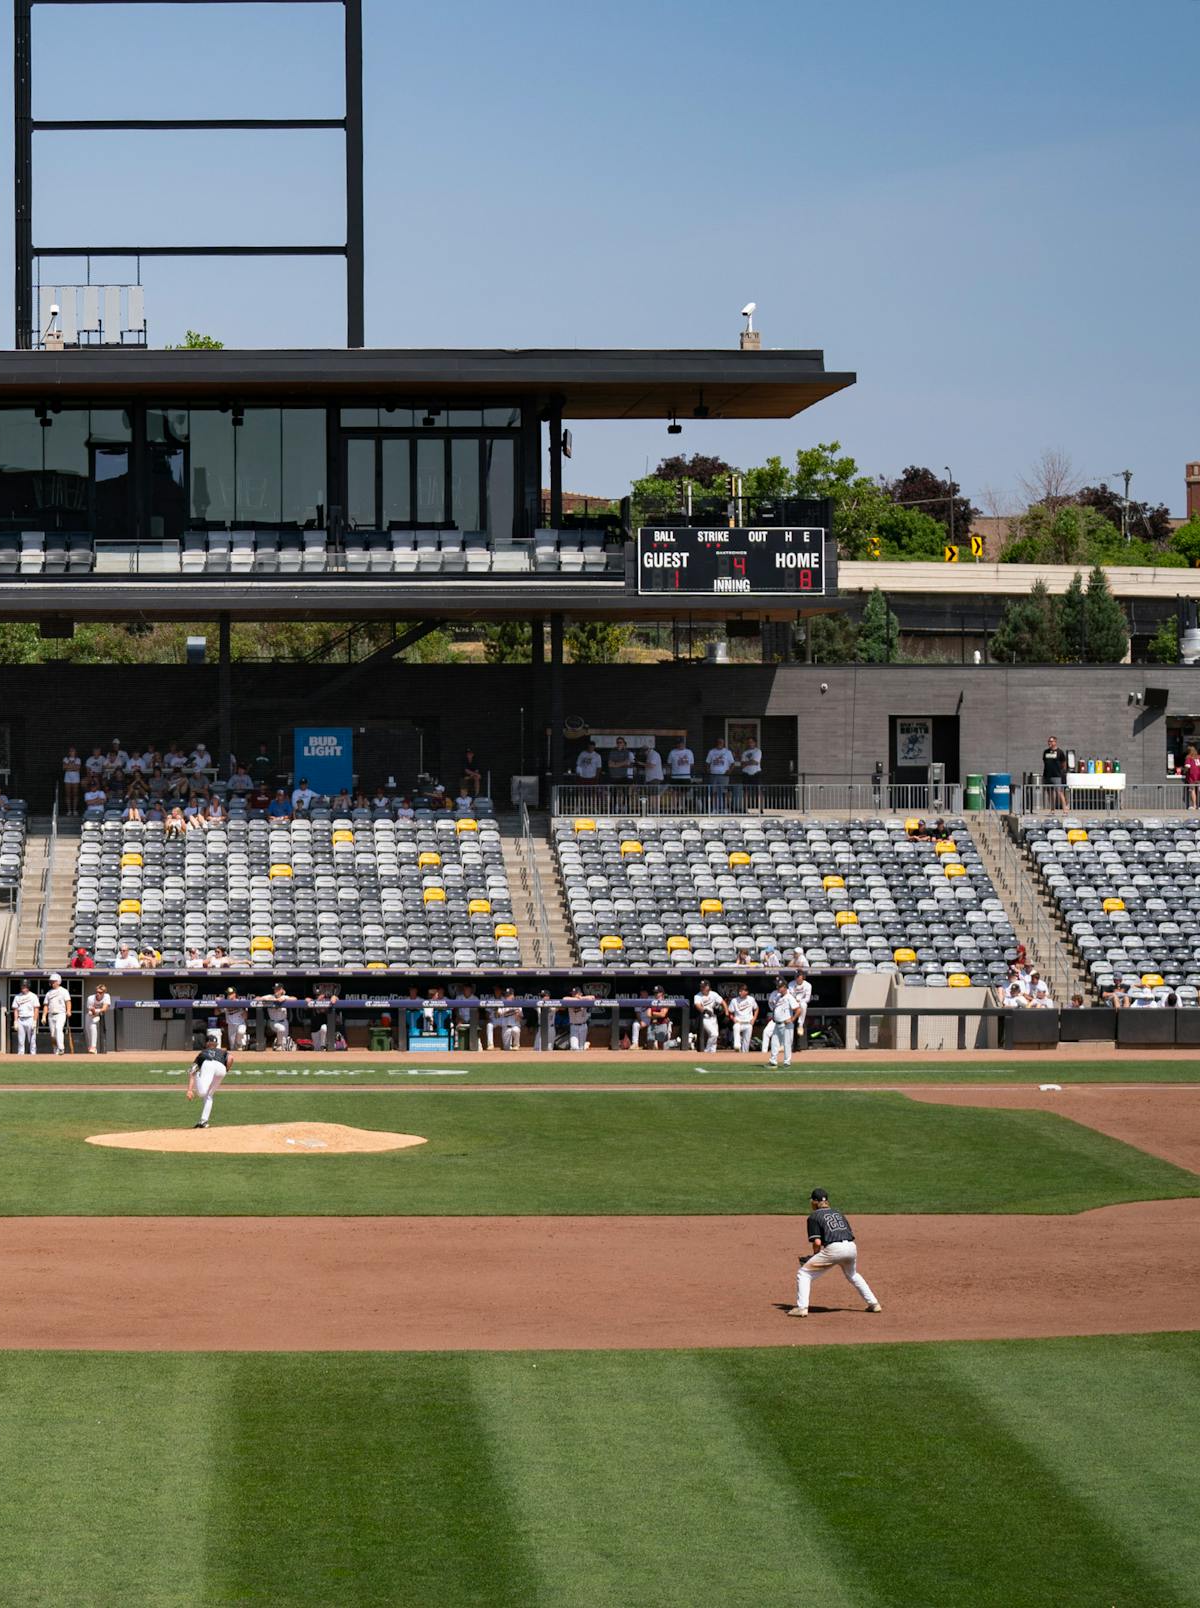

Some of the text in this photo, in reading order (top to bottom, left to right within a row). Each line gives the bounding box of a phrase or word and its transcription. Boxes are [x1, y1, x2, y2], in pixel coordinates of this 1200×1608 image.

[654, 531, 810, 542] BALL STRIKE OUT H E
[643, 552, 689, 568] GUEST
[733, 558, 745, 575] 4
[775, 552, 819, 568] HOME
[713, 579, 750, 592] INNING
[800, 569, 812, 590] 8
[309, 736, 337, 746] BUD
[303, 746, 343, 756] LIGHT
